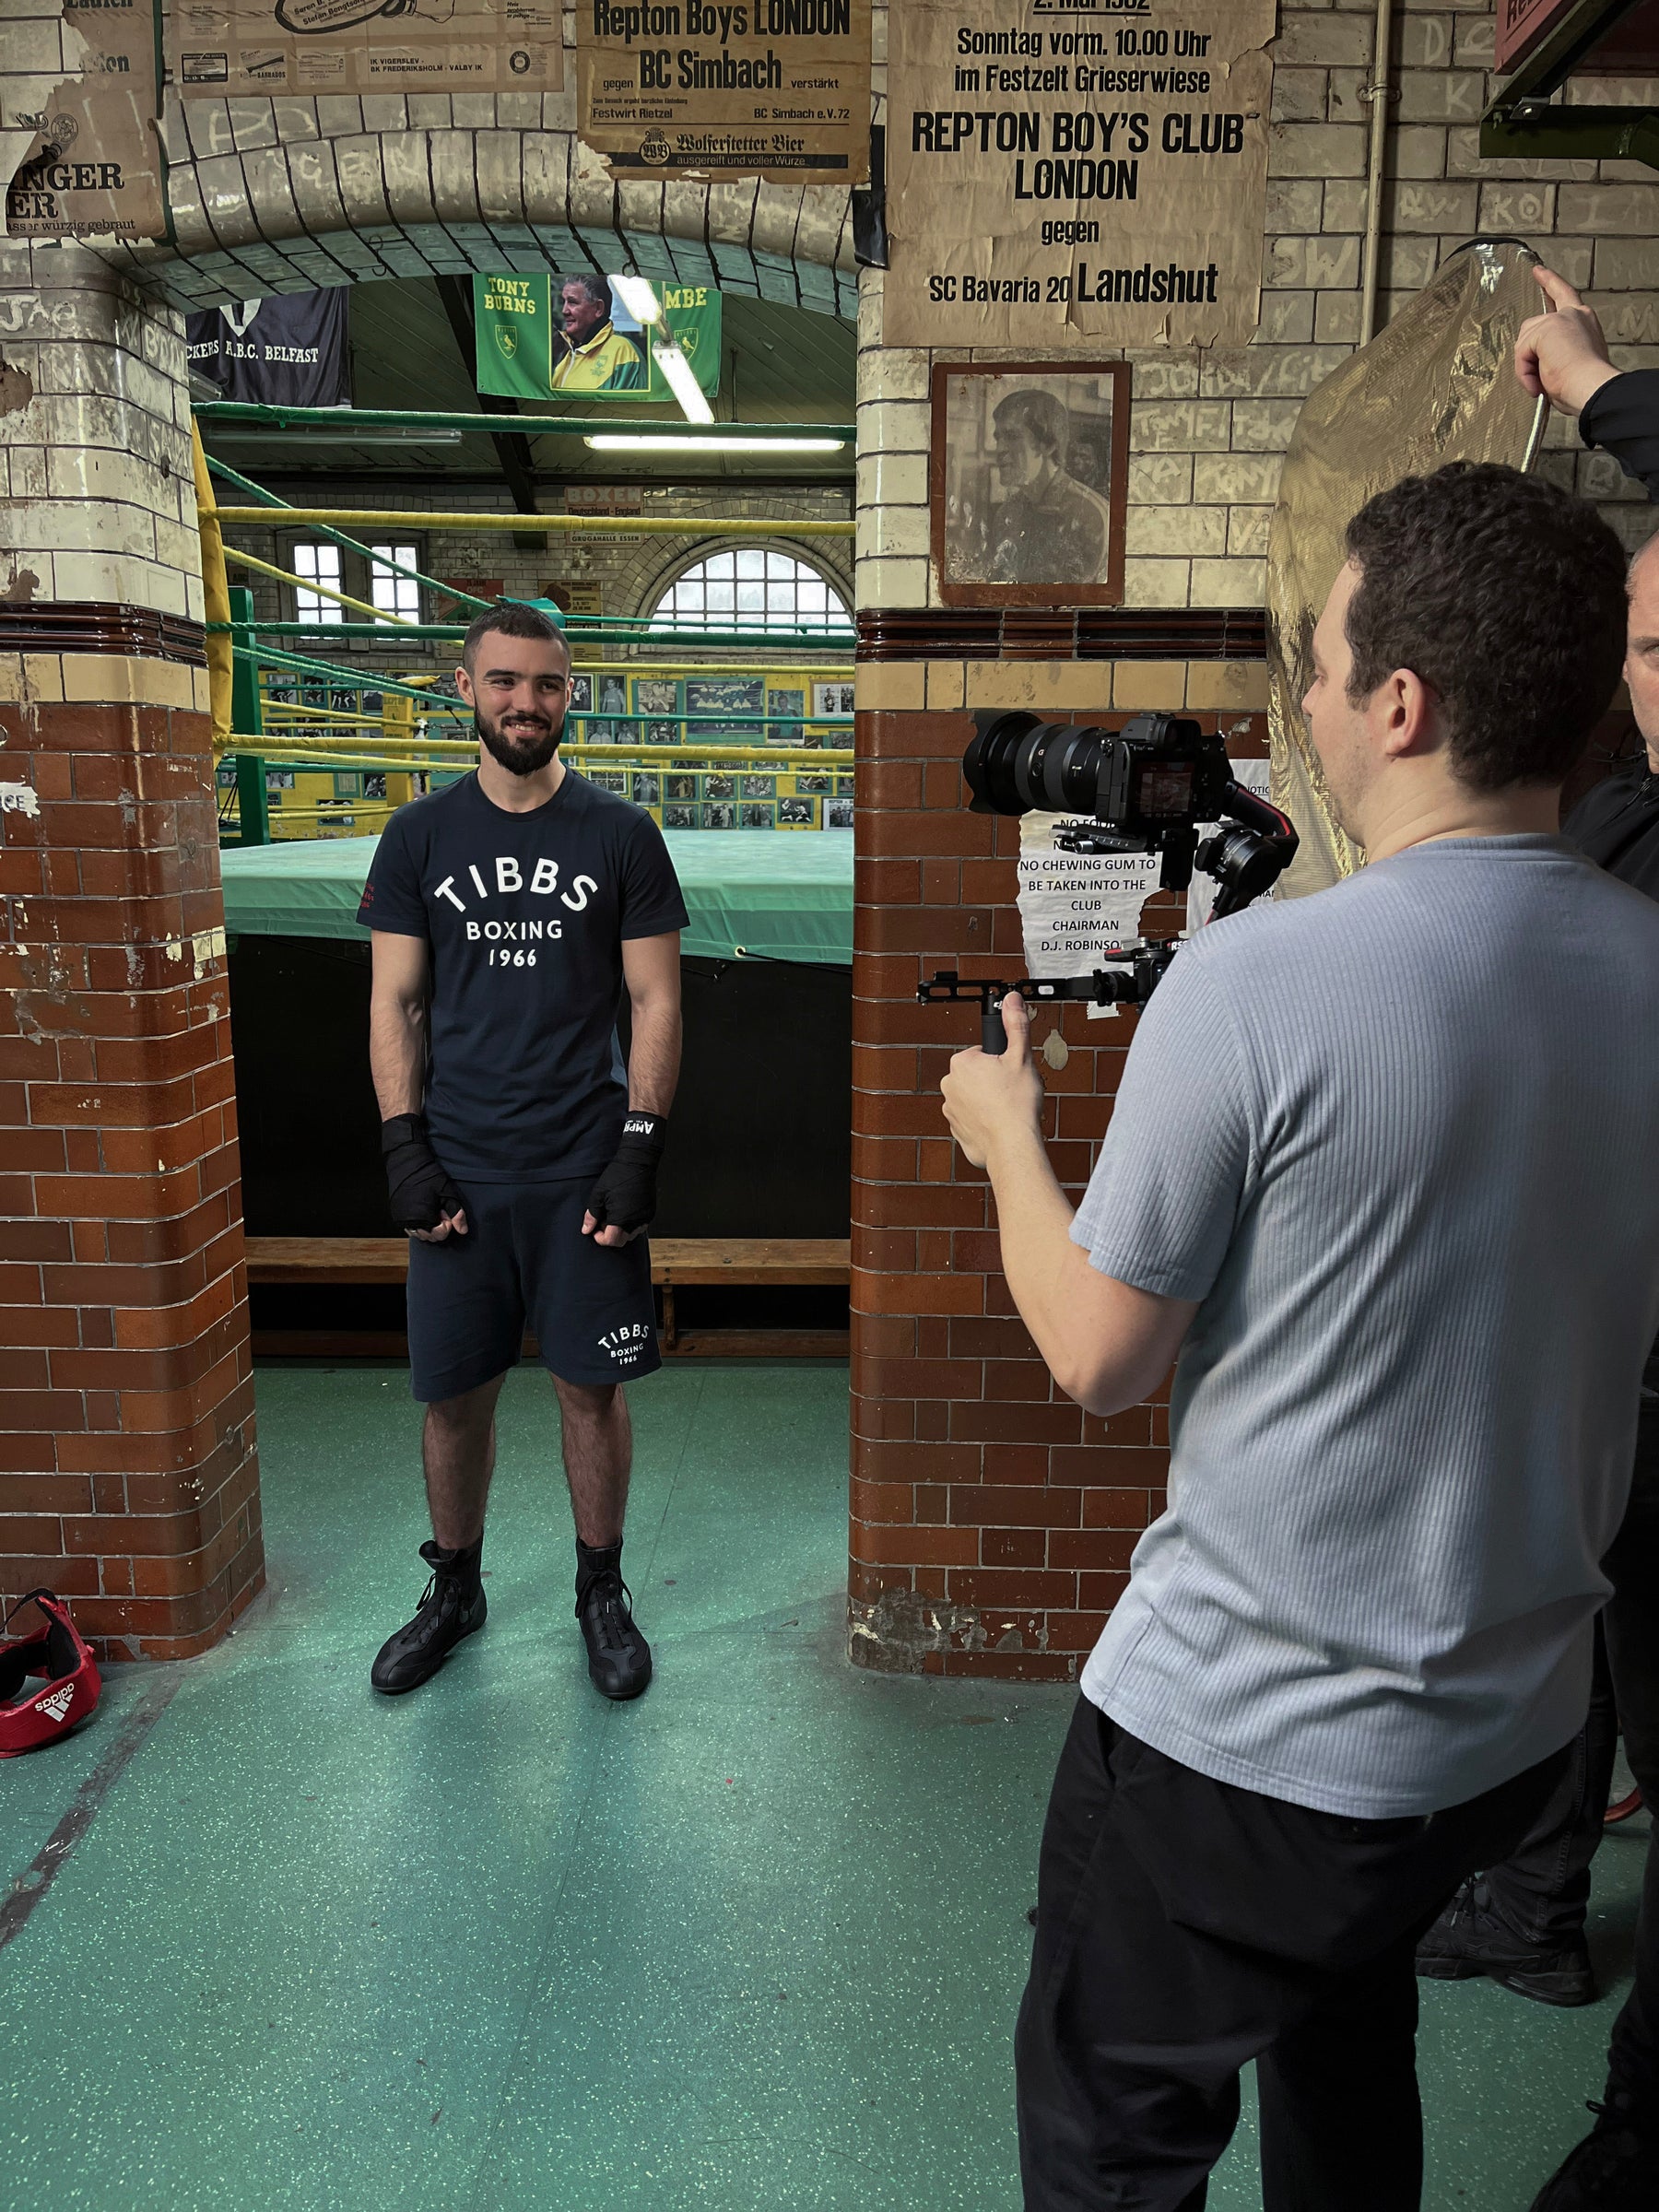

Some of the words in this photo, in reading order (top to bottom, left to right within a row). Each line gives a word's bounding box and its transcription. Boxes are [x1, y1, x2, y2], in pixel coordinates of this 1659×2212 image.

[594, 0, 680, 44] Repton
[687, 0, 747, 44] Boys
[754, 0, 850, 35] LONDON
[957, 28, 1042, 57] Sonntag
[1050, 32, 1108, 55] vorm.
[1115, 29, 1168, 56] 10.00
[1174, 29, 1211, 57] Uhr
[603, 79, 634, 91] gegen
[640, 49, 671, 88] BC
[677, 49, 782, 88] Simbach
[791, 78, 839, 88] verstärkt
[954, 65, 979, 92] im
[986, 65, 1068, 92] Festzelt
[1075, 65, 1210, 93] Grieserwiese
[593, 108, 636, 119] Festwirt
[639, 108, 673, 119] Rietzel
[754, 108, 768, 119] BC
[771, 108, 814, 119] Simbach
[771, 134, 805, 152] Bier
[912, 112, 1040, 152] REPTON
[1053, 112, 1149, 153] BOY'S
[1161, 112, 1244, 154] CLUB
[677, 154, 725, 167] ausgereift
[726, 155, 746, 165] und
[747, 155, 773, 165] voller
[13, 161, 125, 192] NGER
[1015, 159, 1138, 200] LONDON
[41, 218, 85, 232] würzig
[88, 218, 135, 232] gebraut
[1041, 219, 1100, 246] gegen
[488, 277, 530, 297] TONY
[929, 275, 956, 302] SC
[962, 275, 1040, 302] Bavaria
[1046, 276, 1071, 303] 20
[1077, 263, 1218, 303] Landshut
[484, 294, 536, 314] BURNS
[665, 288, 707, 309] MBE
[225, 340, 259, 359] A.B.C.
[265, 346, 319, 363] BELFAST
[567, 488, 641, 502] BOXEN
[568, 507, 609, 516] Deutschland
[615, 507, 641, 516] England
[1019, 861, 1039, 871] NO
[1042, 860, 1101, 871] CHEWING
[1104, 859, 1135, 870] GUM
[1139, 859, 1156, 870] TO
[434, 856, 598, 912] TIBBS
[1029, 881, 1043, 891] BE
[1046, 880, 1087, 891] TAKEN
[1090, 880, 1120, 891] INTO
[1123, 879, 1146, 890] THE
[1071, 900, 1101, 911] CLUB
[465, 920, 562, 940] BOXING
[1053, 921, 1119, 931] CHAIRMAN
[1041, 941, 1062, 951] D.J.
[488, 948, 536, 967] 1966
[597, 1324, 650, 1349] TIBBS
[610, 1343, 644, 1358] BOXING
[619, 1354, 638, 1365] 1966
[34, 1682, 75, 1712] adidas
